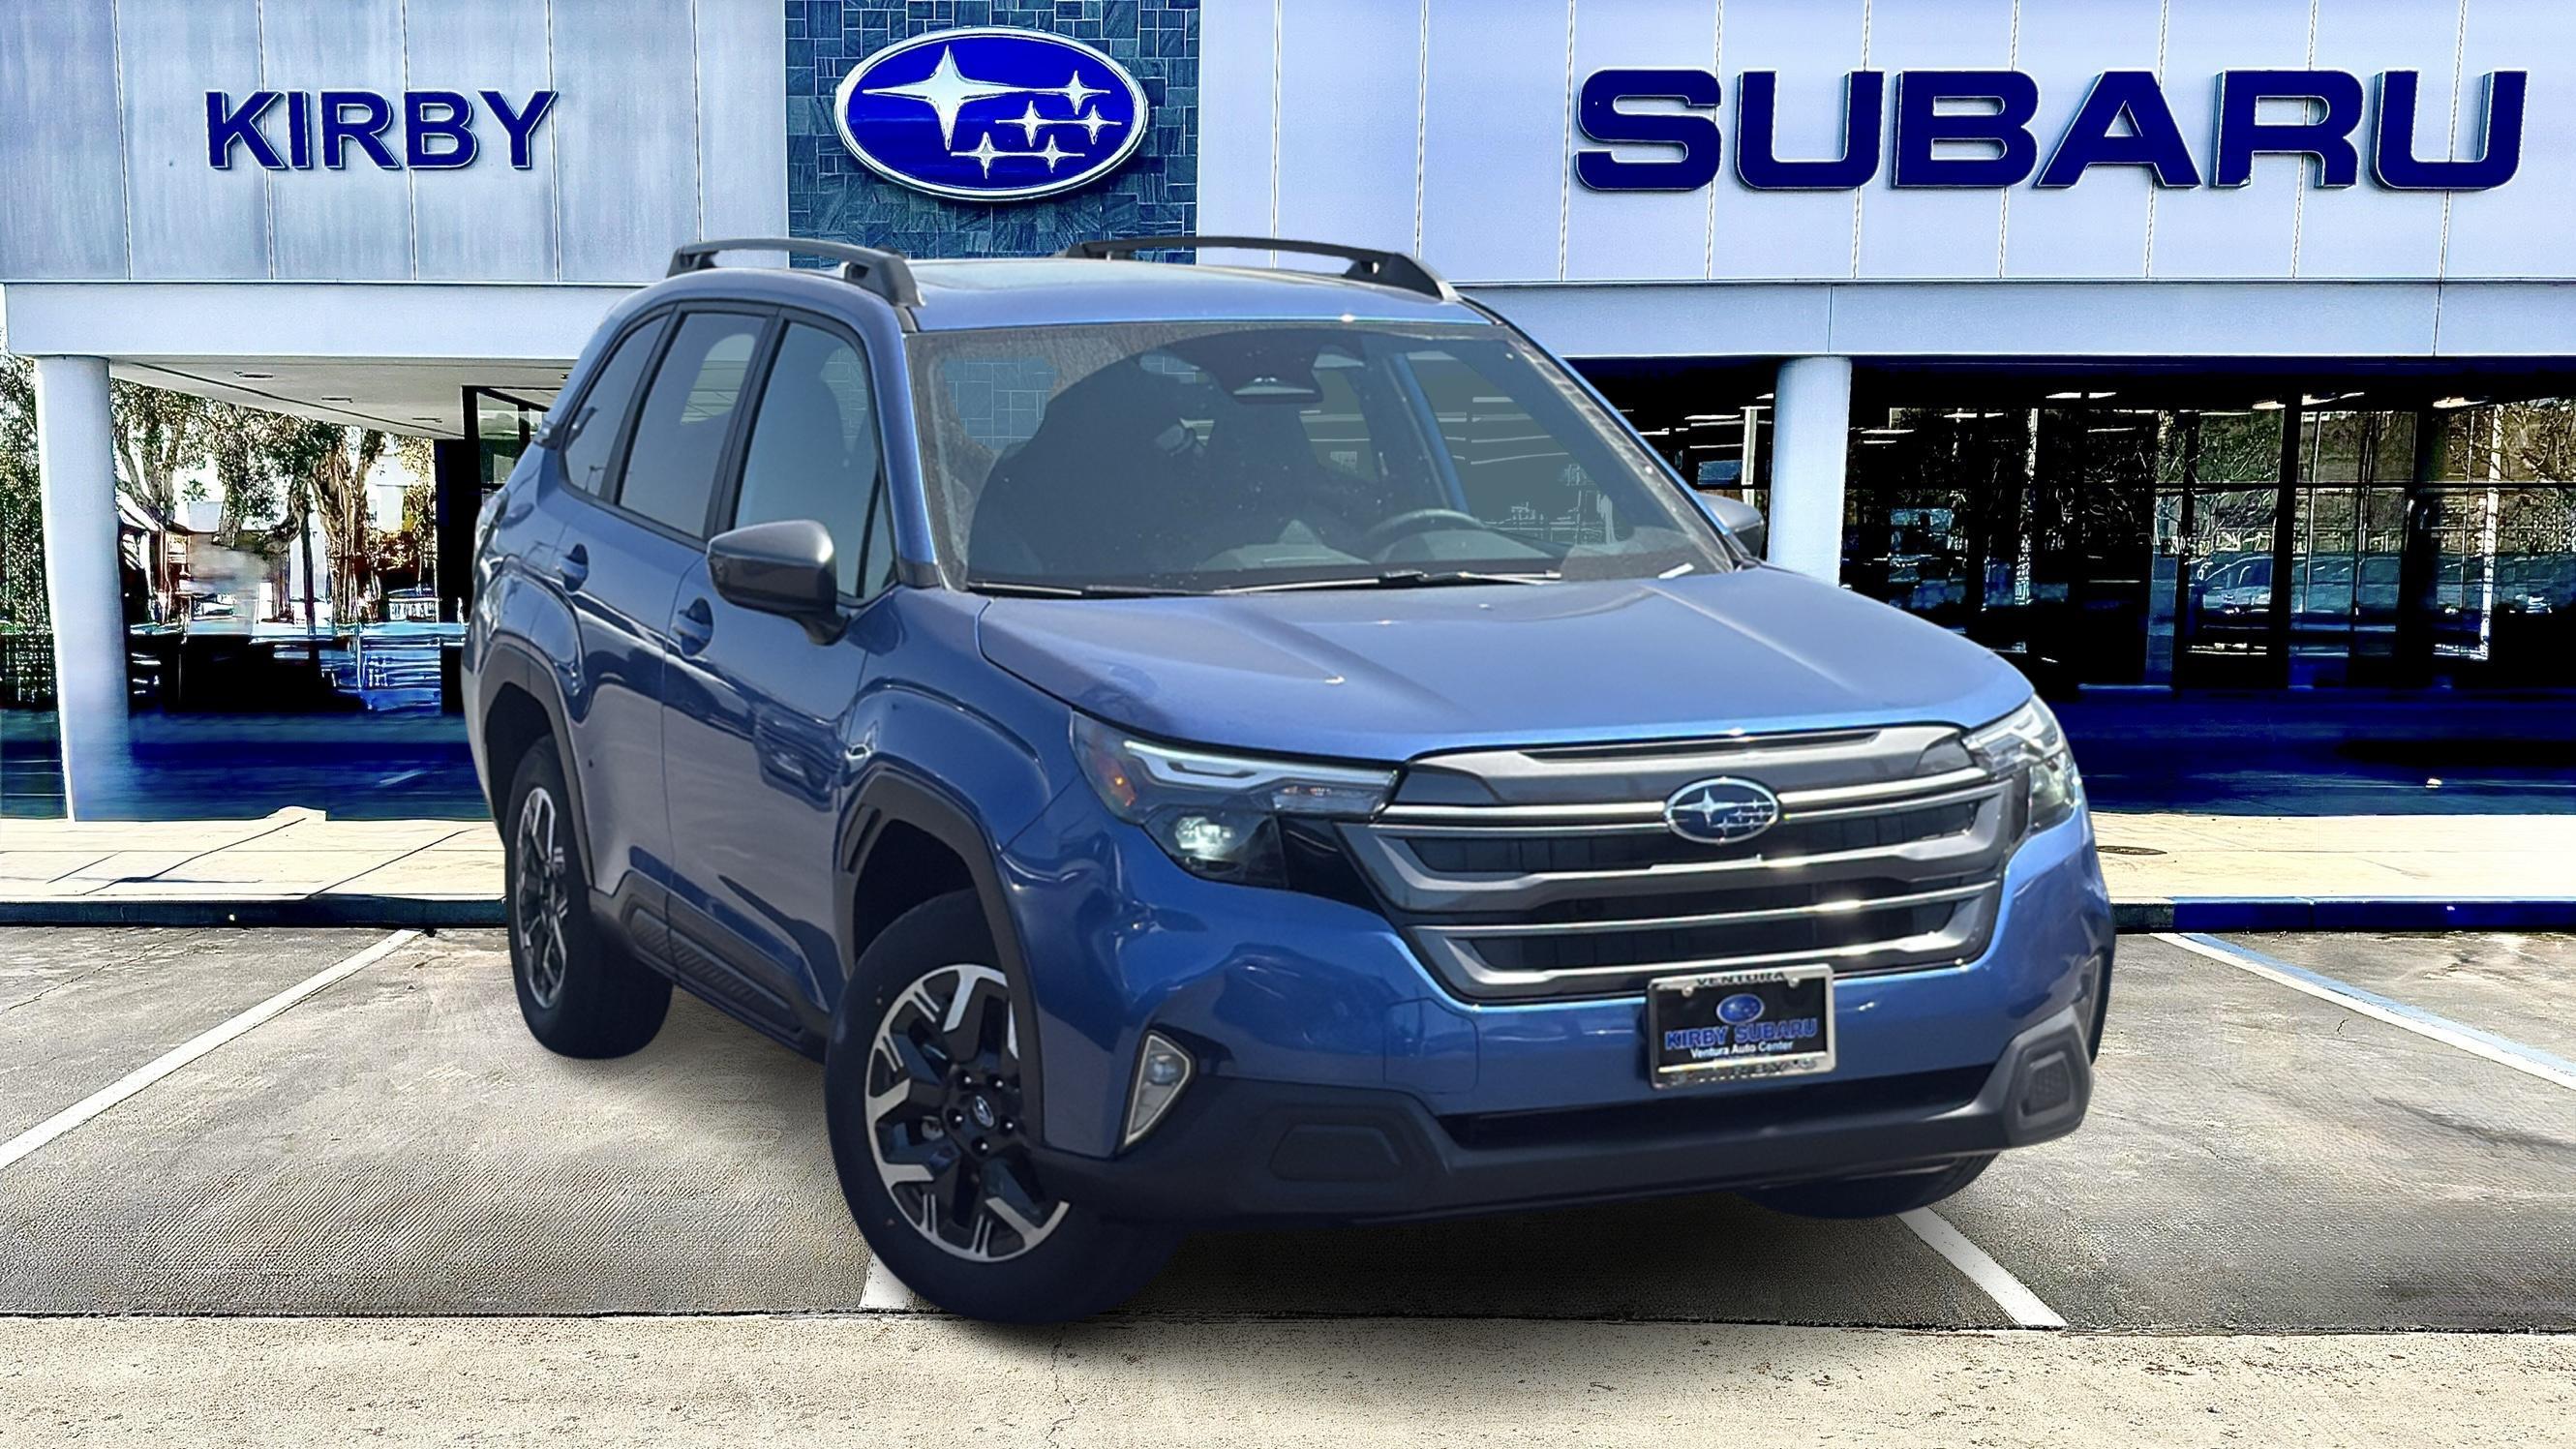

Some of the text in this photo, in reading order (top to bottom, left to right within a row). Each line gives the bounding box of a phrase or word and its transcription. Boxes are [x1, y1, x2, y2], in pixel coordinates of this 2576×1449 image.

[204, 90, 558, 170] KIRBY
[1575, 69, 2528, 192] SUBARU
[1697, 972, 1786, 985] VENTURA
[1665, 1018, 1817, 1049] KIRBY SUBARU
[1691, 1046, 1730, 1059] Ventura
[1731, 1043, 1756, 1054] Auto
[1758, 1041, 1794, 1052] Center
